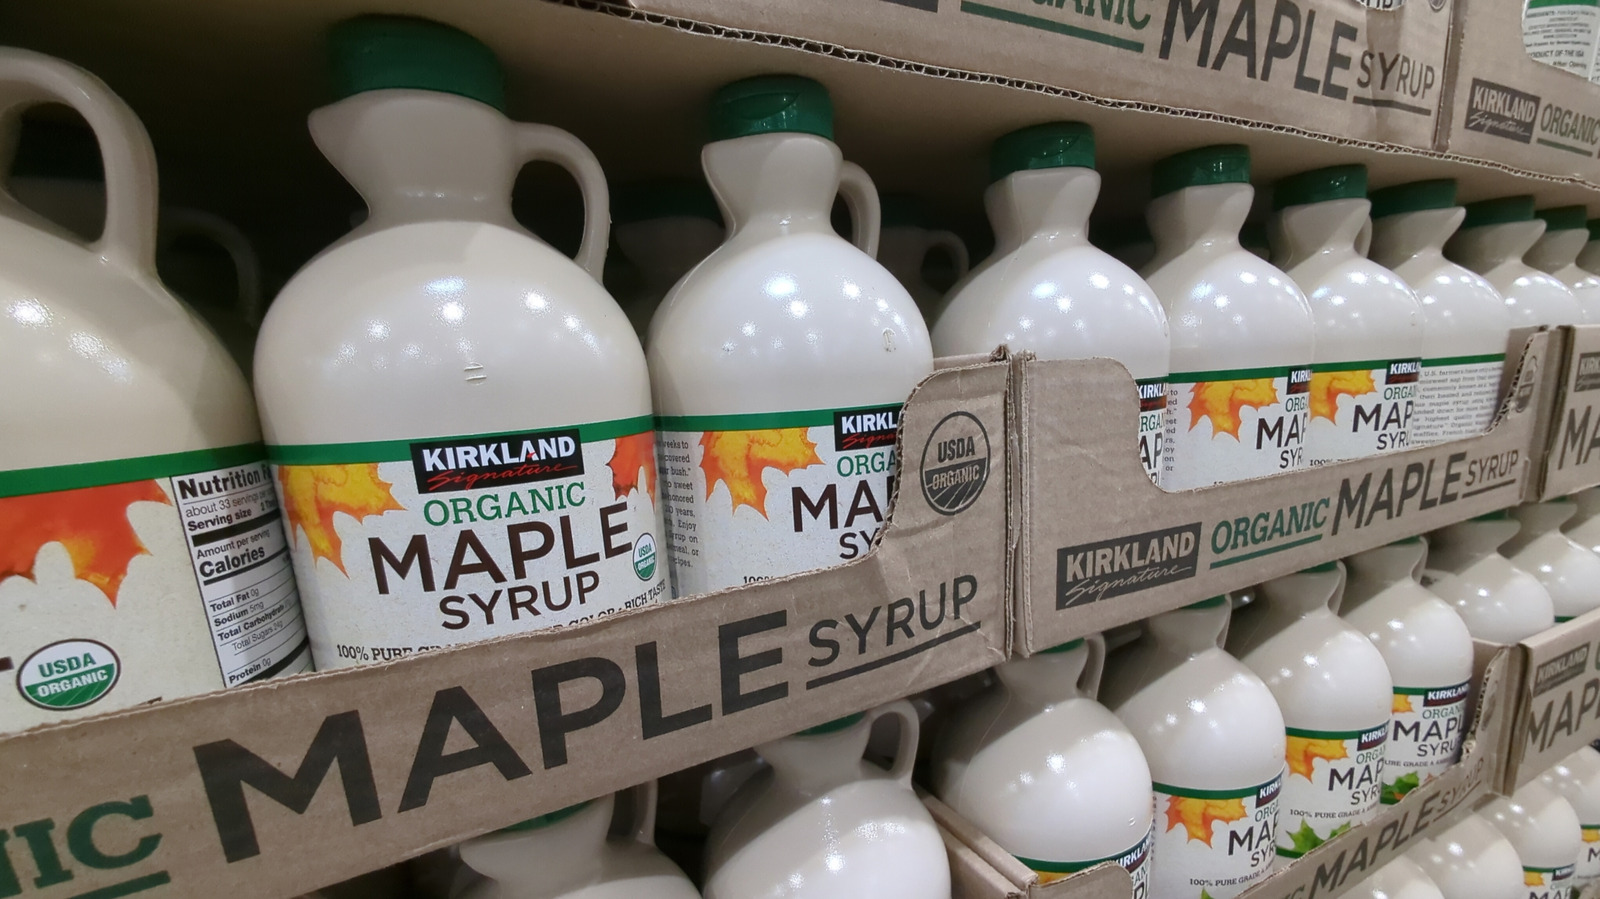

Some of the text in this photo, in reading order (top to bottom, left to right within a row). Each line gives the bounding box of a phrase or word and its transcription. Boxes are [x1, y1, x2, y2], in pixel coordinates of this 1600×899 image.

[1159, 0, 1358, 101] MAPLE
[1357, 50, 1435, 99] SYRUP
[1473, 86, 1537, 124] KIRKLAND
[1468, 111, 1531, 137] Signature
[1540, 103, 1600, 146] ORGANIC
[1352, 400, 1414, 432] MAP
[422, 436, 576, 472] KIRKLAND
[937, 435, 976, 463] USDA
[178, 469, 261, 500] Nutrition
[427, 462, 578, 491] Signature
[932, 464, 980, 490] ORGANIC
[185, 503, 218, 518] about
[219, 499, 231, 510] 33
[423, 481, 586, 527] ORGANIC
[1211, 449, 1518, 554] ORGANIC MAPLE SYRUP
[187, 514, 233, 531] Serving
[235, 508, 252, 520] size
[196, 541, 235, 559] Amount
[236, 536, 249, 549] per
[199, 546, 265, 578] Calories
[368, 502, 633, 595] MAPLE
[1066, 531, 1195, 583] KIRKLAND
[1065, 564, 1192, 606] Signature
[210, 597, 235, 612] Total
[236, 592, 250, 603] Fat
[439, 570, 600, 630] SYRUP
[214, 608, 249, 627] Sodium
[217, 626, 242, 641] Total
[232, 636, 251, 651] Total
[251, 626, 273, 640] Sugars
[37, 652, 97, 679] USDA
[336, 644, 369, 661] 100%
[37, 669, 109, 698] ORGANIC
[228, 663, 262, 684] Protein
[192, 608, 789, 864] MAPLE
[807, 574, 978, 668] SYRUP
[1290, 809, 1312, 818] 100%
[1308, 792, 1439, 899] MAPLE
[1189, 878, 1213, 886] 100%
[1215, 878, 1237, 886] PURE
